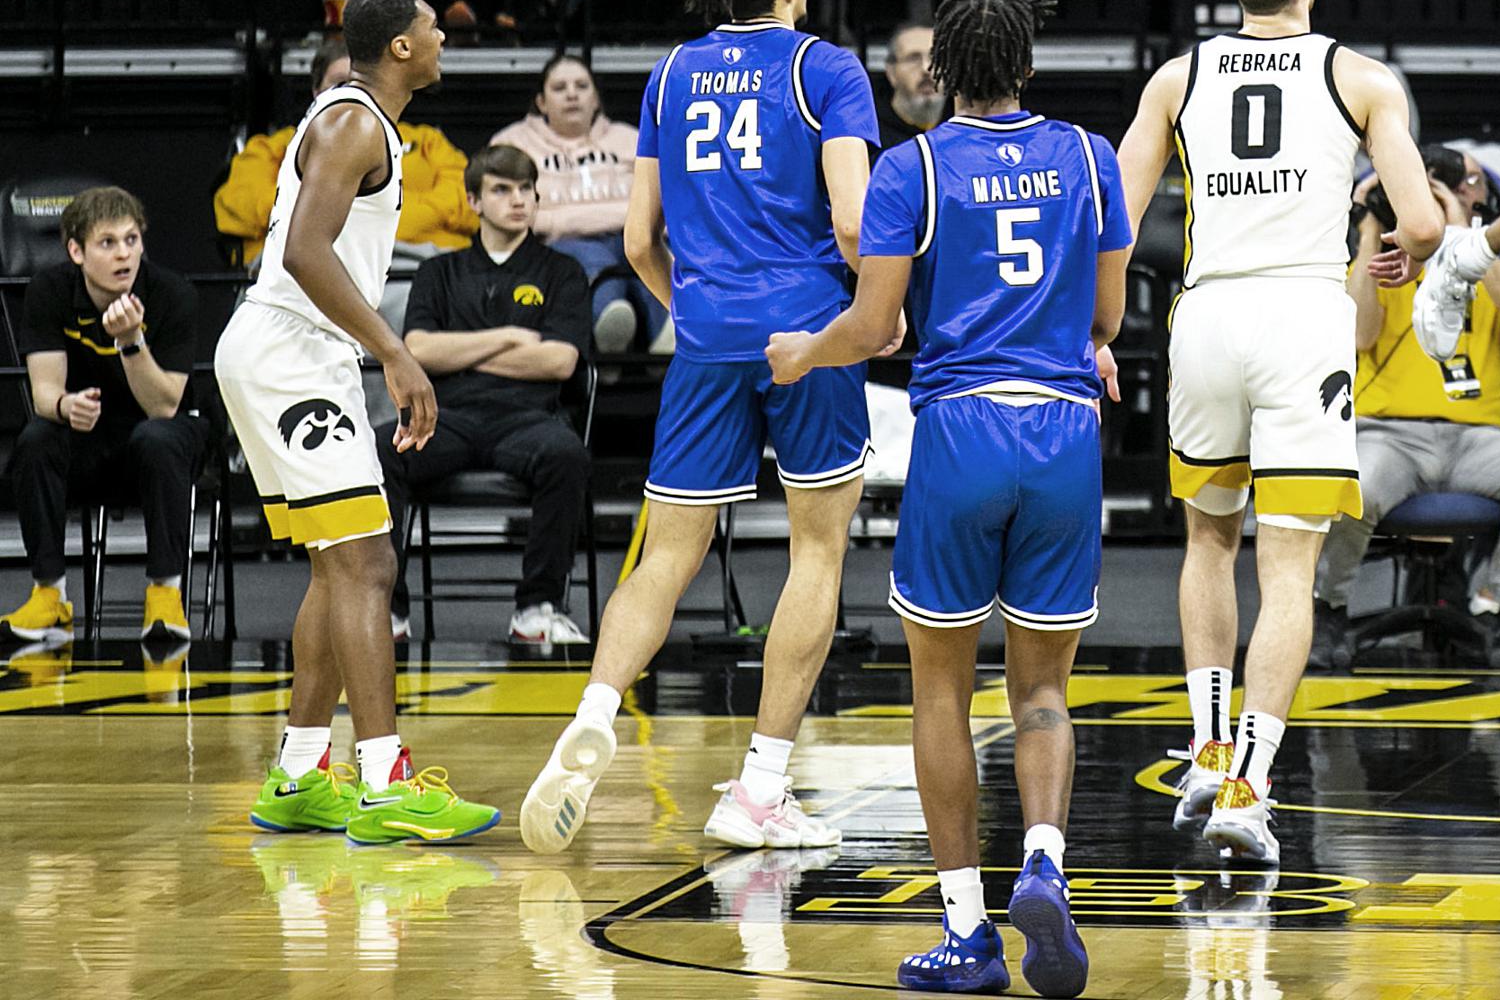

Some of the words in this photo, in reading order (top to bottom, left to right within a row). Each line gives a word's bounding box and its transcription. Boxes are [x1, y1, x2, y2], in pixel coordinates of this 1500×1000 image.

[1218, 53, 1301, 74] REBRACA
[691, 69, 763, 95] THOMAS
[686, 98, 762, 172] 24
[1231, 84, 1282, 160] 0
[972, 169, 1062, 203] MALONE
[1207, 169, 1308, 198] EQUALITY
[995, 207, 1045, 286] 5
